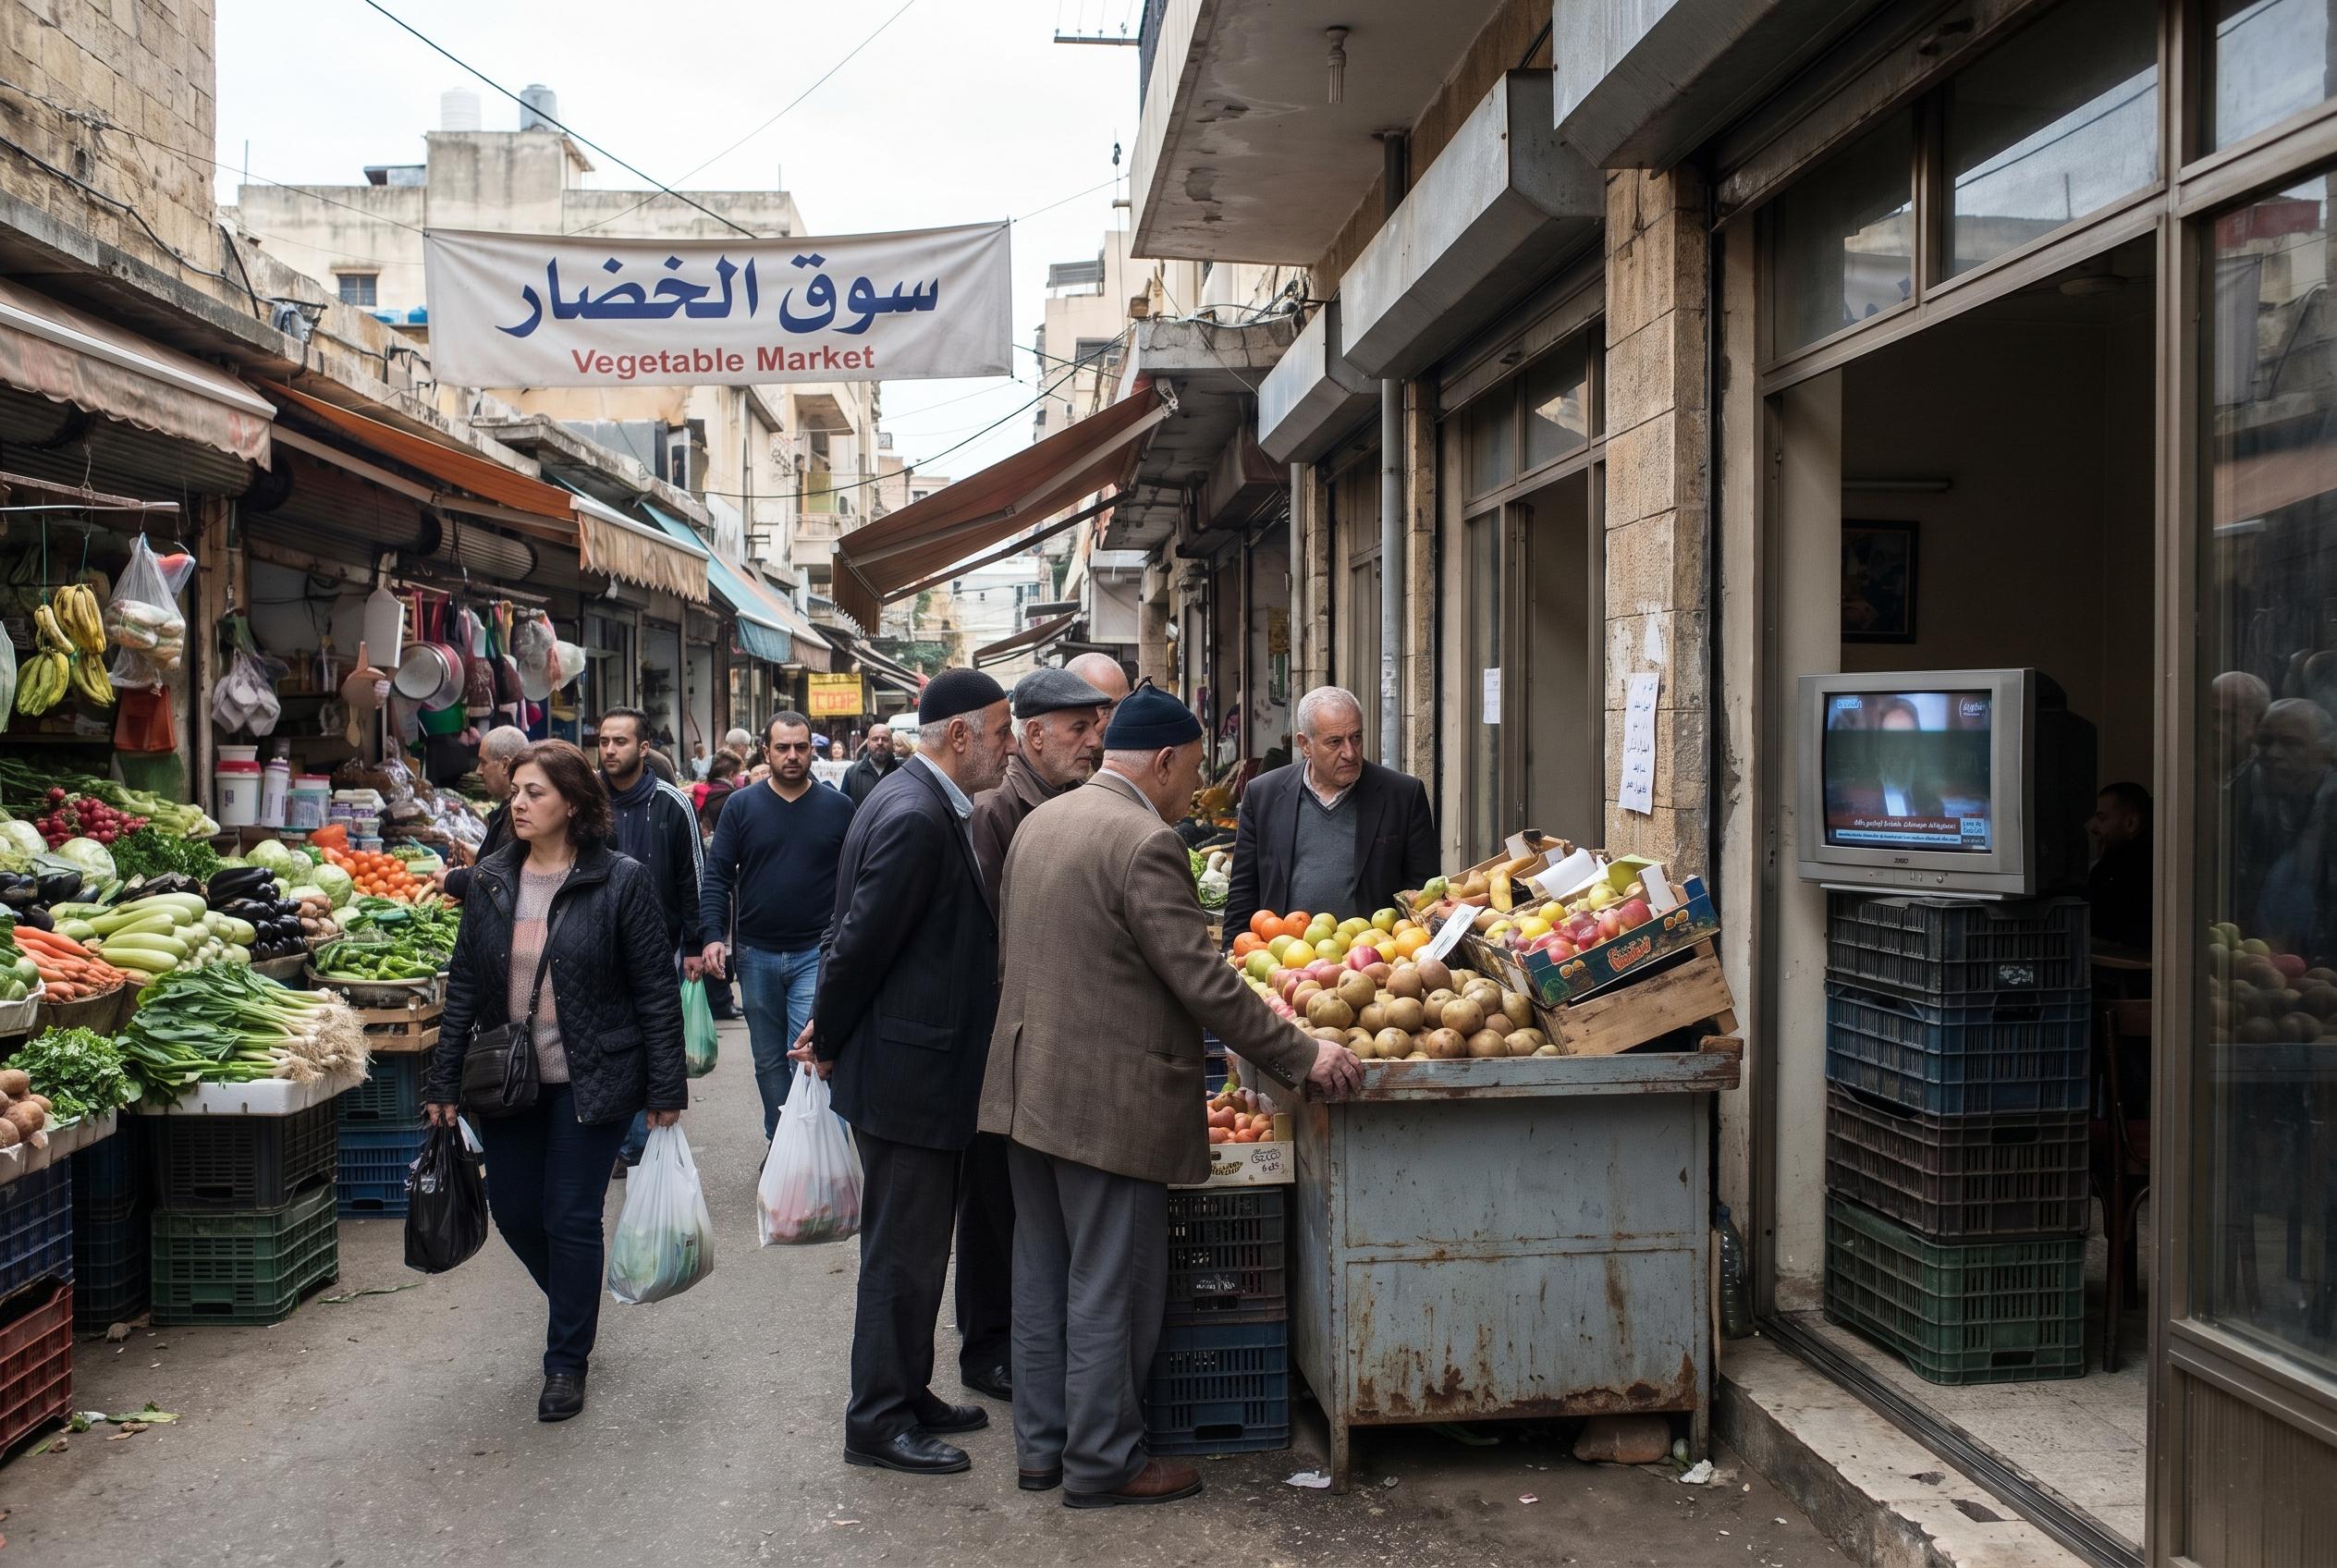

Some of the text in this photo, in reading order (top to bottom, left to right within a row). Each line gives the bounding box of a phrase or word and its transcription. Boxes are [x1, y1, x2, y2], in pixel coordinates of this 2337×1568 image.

[495, 253, 937, 338] سوق الخضار
[572, 345, 875, 382] Vegetable Market
